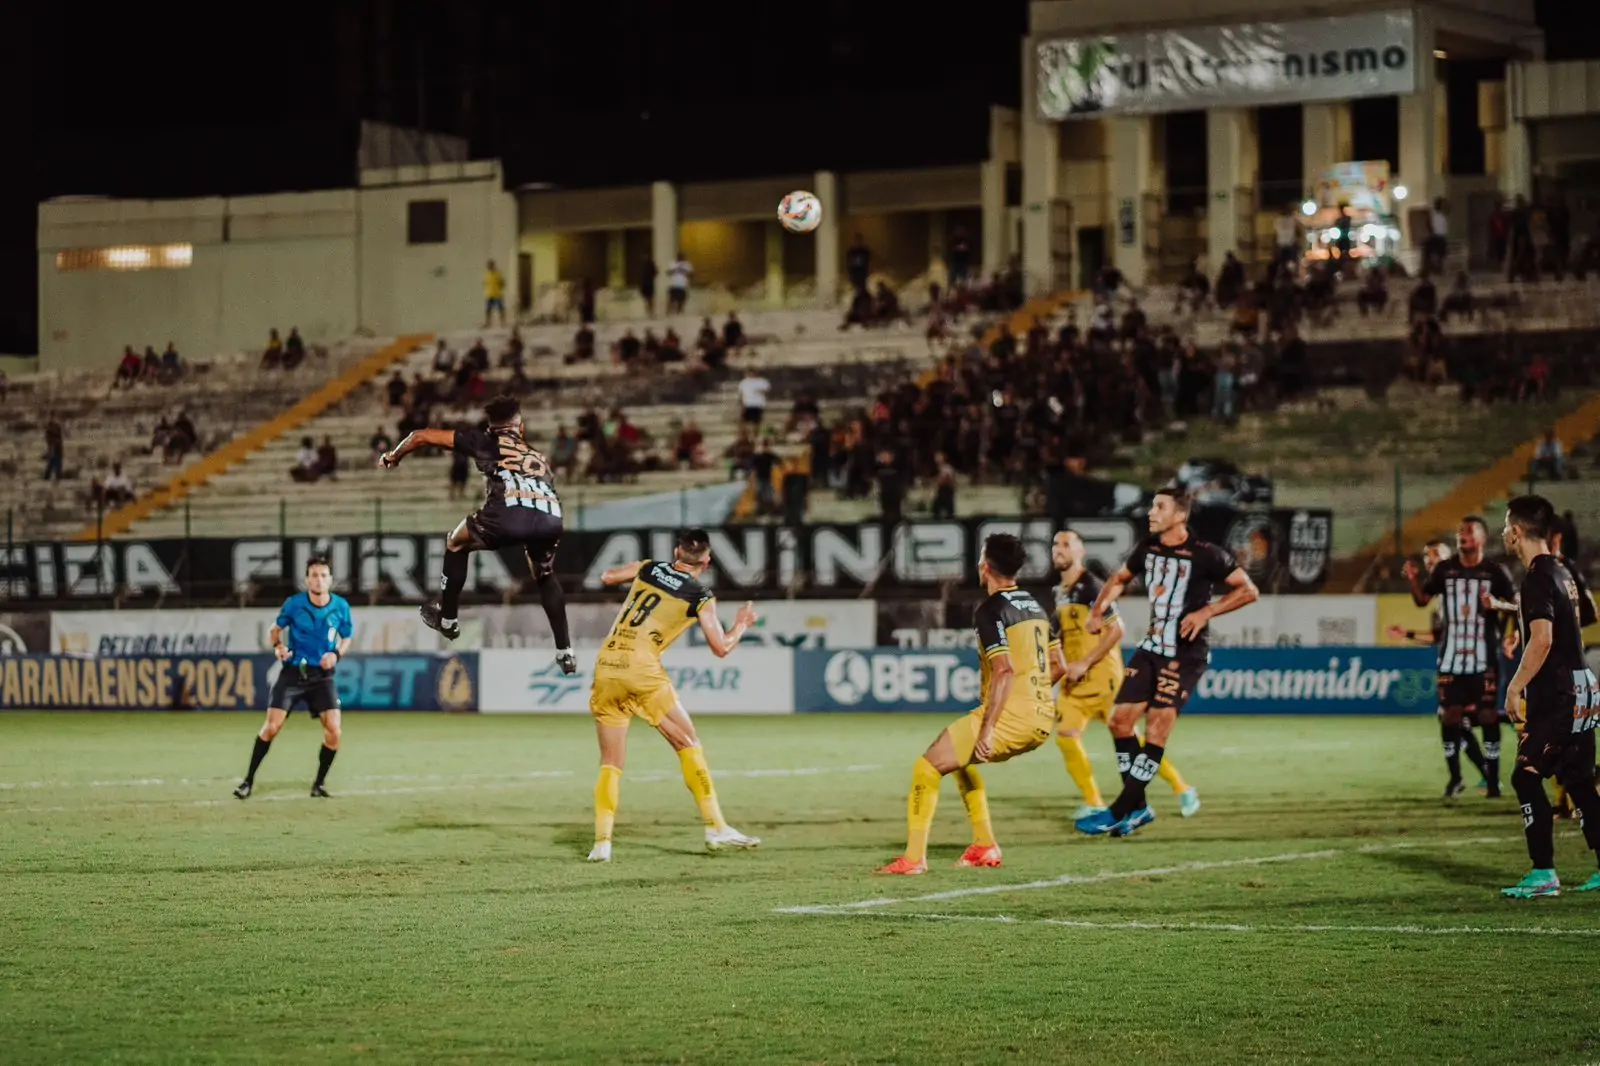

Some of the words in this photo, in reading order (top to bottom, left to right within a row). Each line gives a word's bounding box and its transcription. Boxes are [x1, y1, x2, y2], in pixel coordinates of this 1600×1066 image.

[619, 588, 662, 628] 18
[0, 658, 174, 707] ARANAENSE
[178, 658, 256, 707] 2024
[871, 654, 982, 703] BETe
